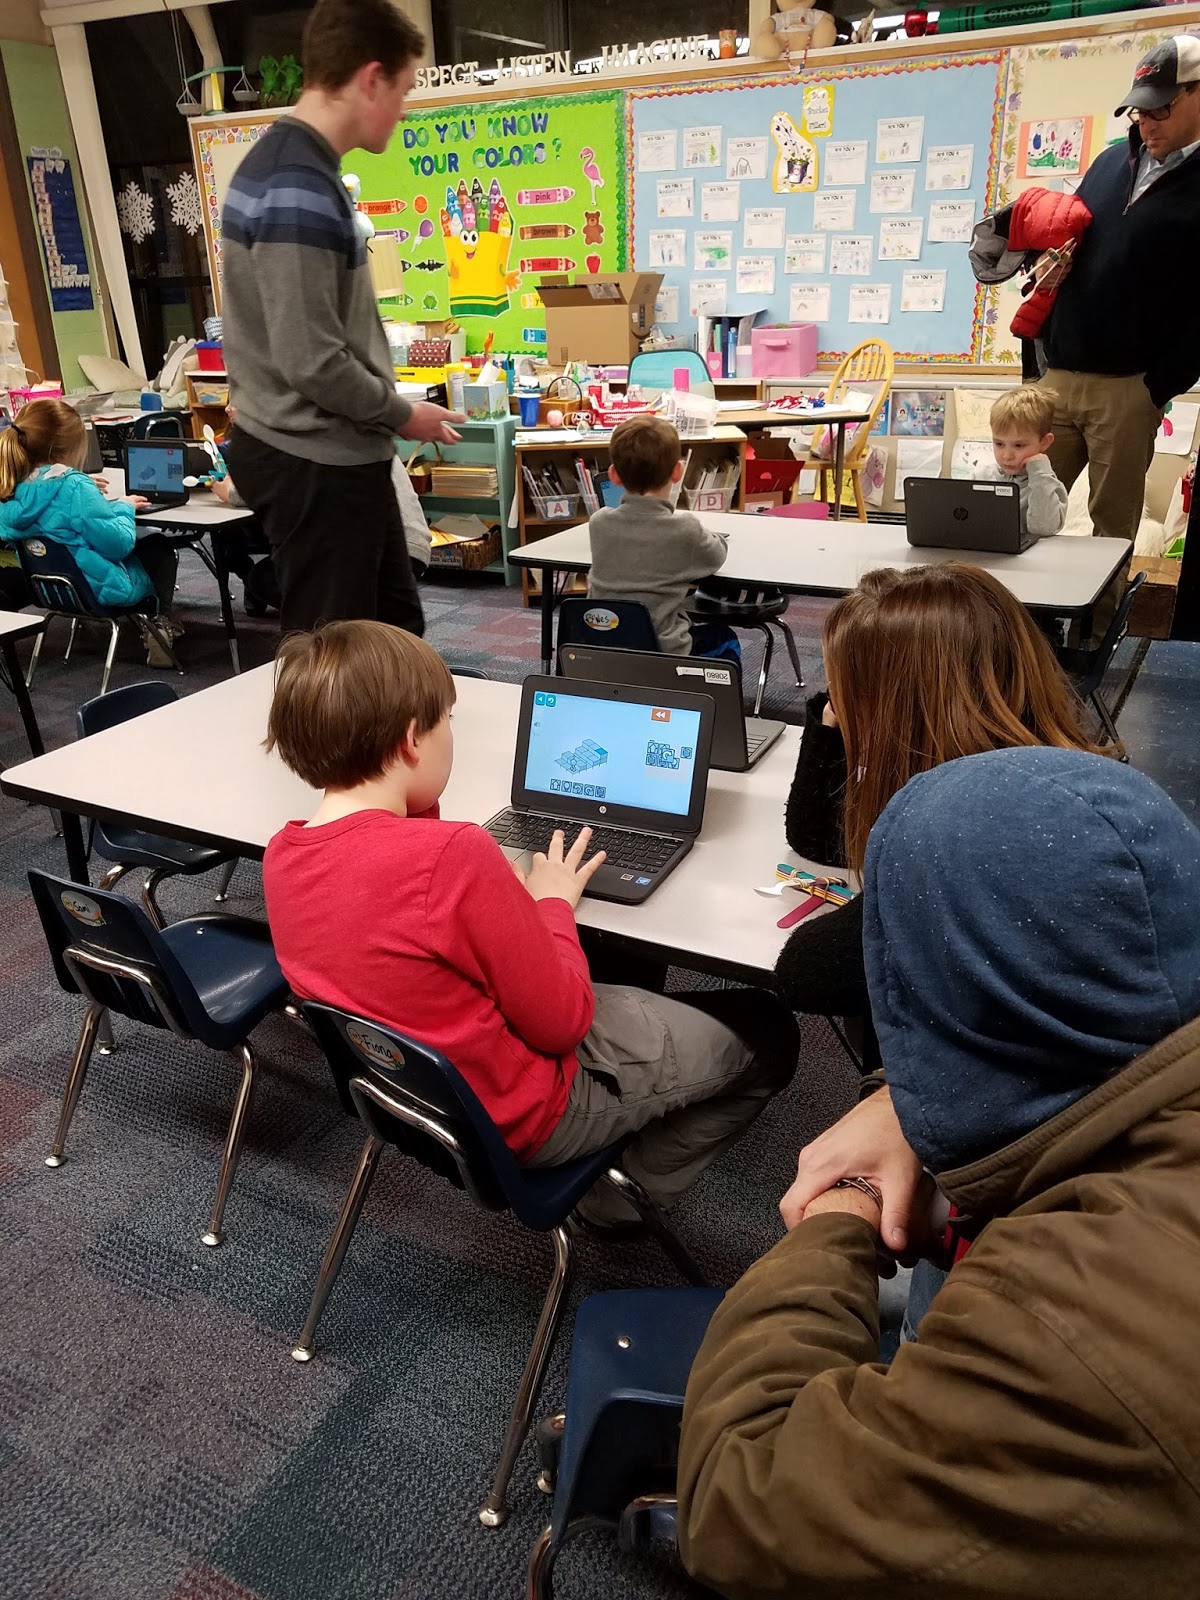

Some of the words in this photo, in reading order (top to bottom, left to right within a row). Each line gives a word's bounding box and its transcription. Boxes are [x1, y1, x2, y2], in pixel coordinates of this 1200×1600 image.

[988, 3, 1048, 20] CRAYON
[414, 60, 478, 89] SPECT
[496, 50, 571, 80] LISTEN
[601, 34, 708, 67] IMAGINE
[402, 126, 430, 149] DO
[435, 118, 476, 144] YOU
[487, 112, 548, 139] KNOW
[408, 152, 459, 176] YOUR
[535, 192, 552, 203] pink
[368, 204, 391, 213] orange
[532, 226, 557, 236] brown
[538, 260, 551, 268] red
[707, 496, 717, 506] D
[554, 502, 564, 514] A
[593, 614, 610, 624] Wes
[361, 1034, 392, 1059] Fiona
